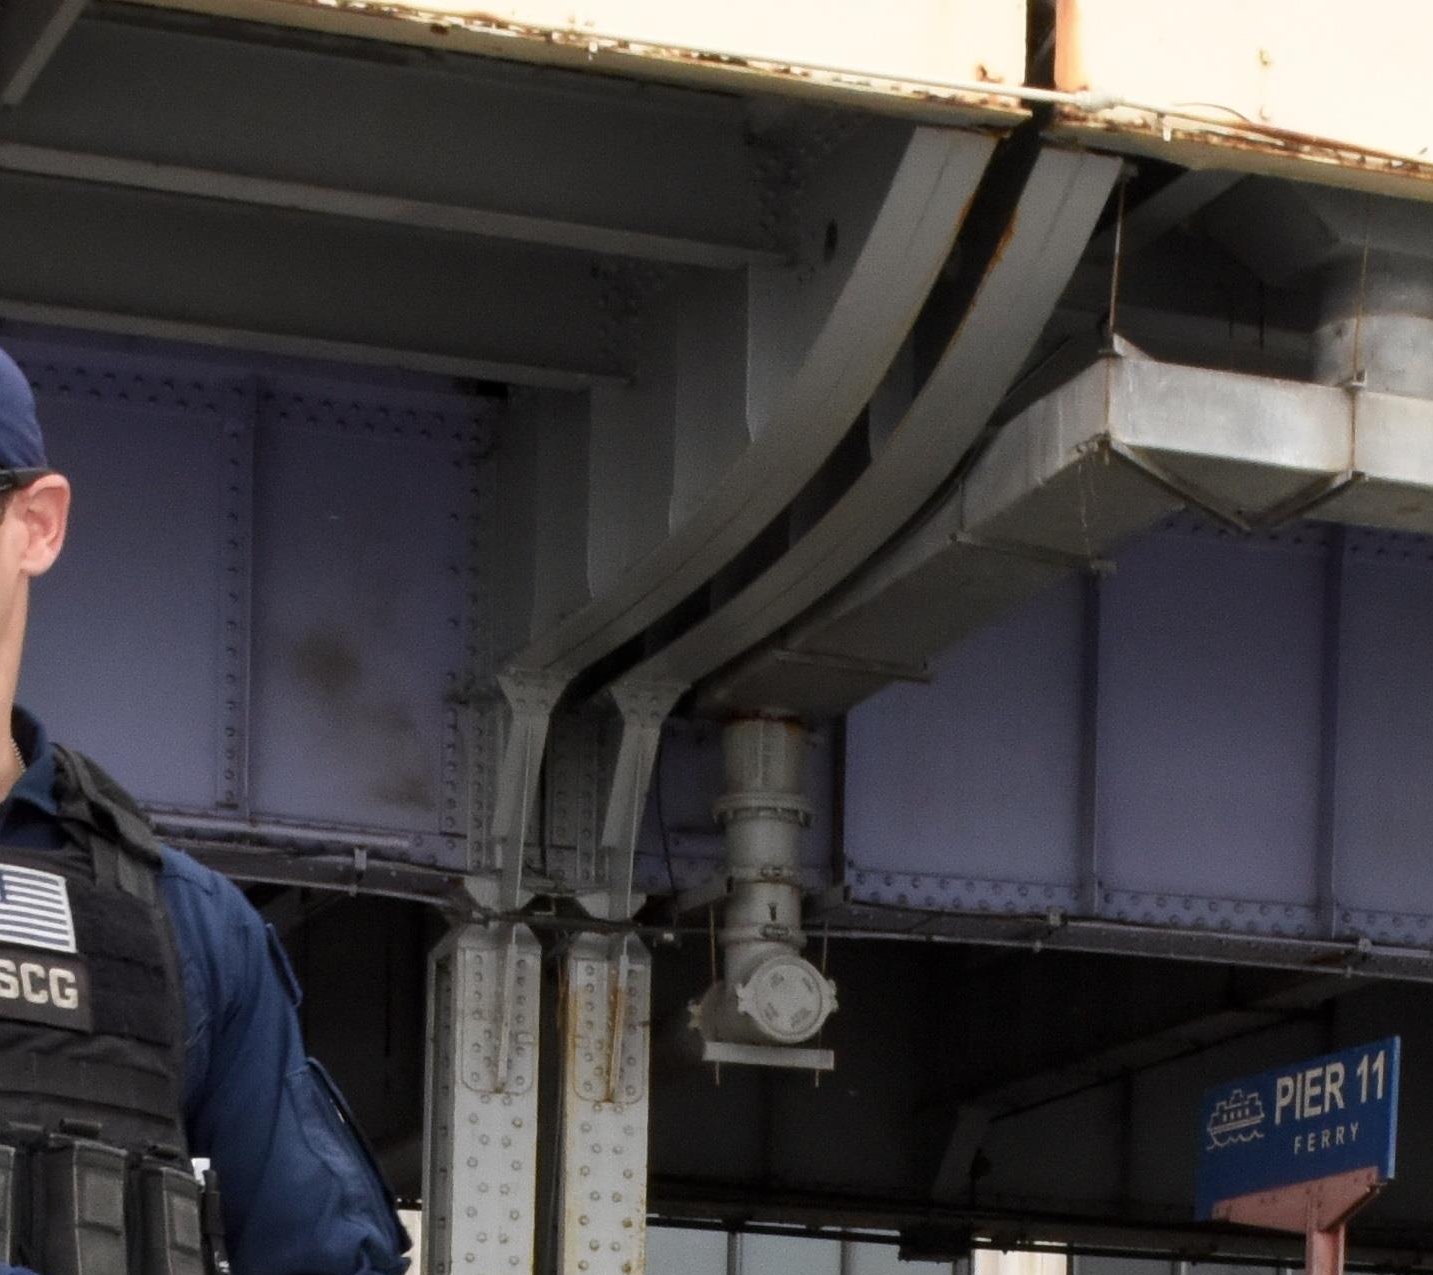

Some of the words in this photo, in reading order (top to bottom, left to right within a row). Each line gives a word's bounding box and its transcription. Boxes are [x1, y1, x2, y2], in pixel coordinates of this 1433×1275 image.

[1275, 1062, 1345, 1125] PIER
[1357, 1050, 1385, 1103] 11
[1294, 1122, 1359, 1154] FERRY
